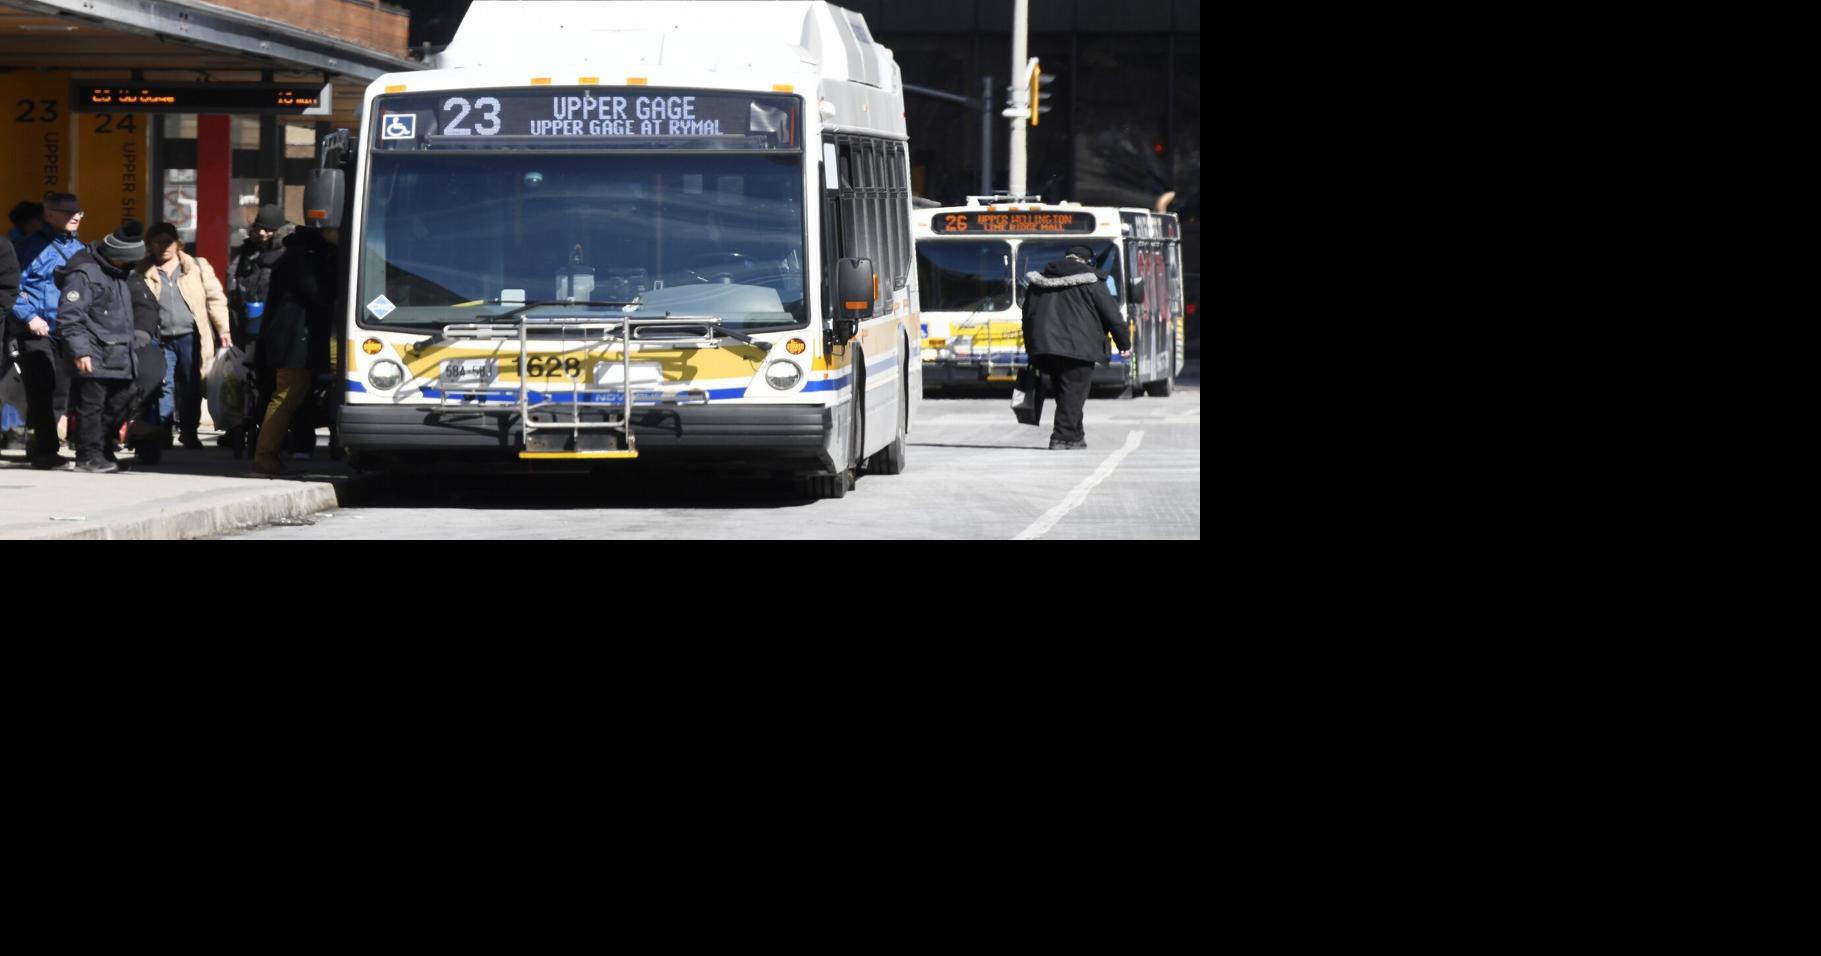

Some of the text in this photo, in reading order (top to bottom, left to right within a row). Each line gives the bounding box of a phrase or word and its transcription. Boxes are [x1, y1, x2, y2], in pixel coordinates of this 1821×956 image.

[15, 99, 58, 123] 23
[443, 97, 501, 136] 23
[553, 96, 696, 119] UPPER GAGE
[94, 112, 137, 134] 24
[531, 119, 724, 136] UPPER GAGE AT RYMAL
[43, 131, 59, 185] UPPER
[121, 142, 137, 193] UPPER
[945, 214, 968, 232] 26
[512, 356, 581, 378] 1628
